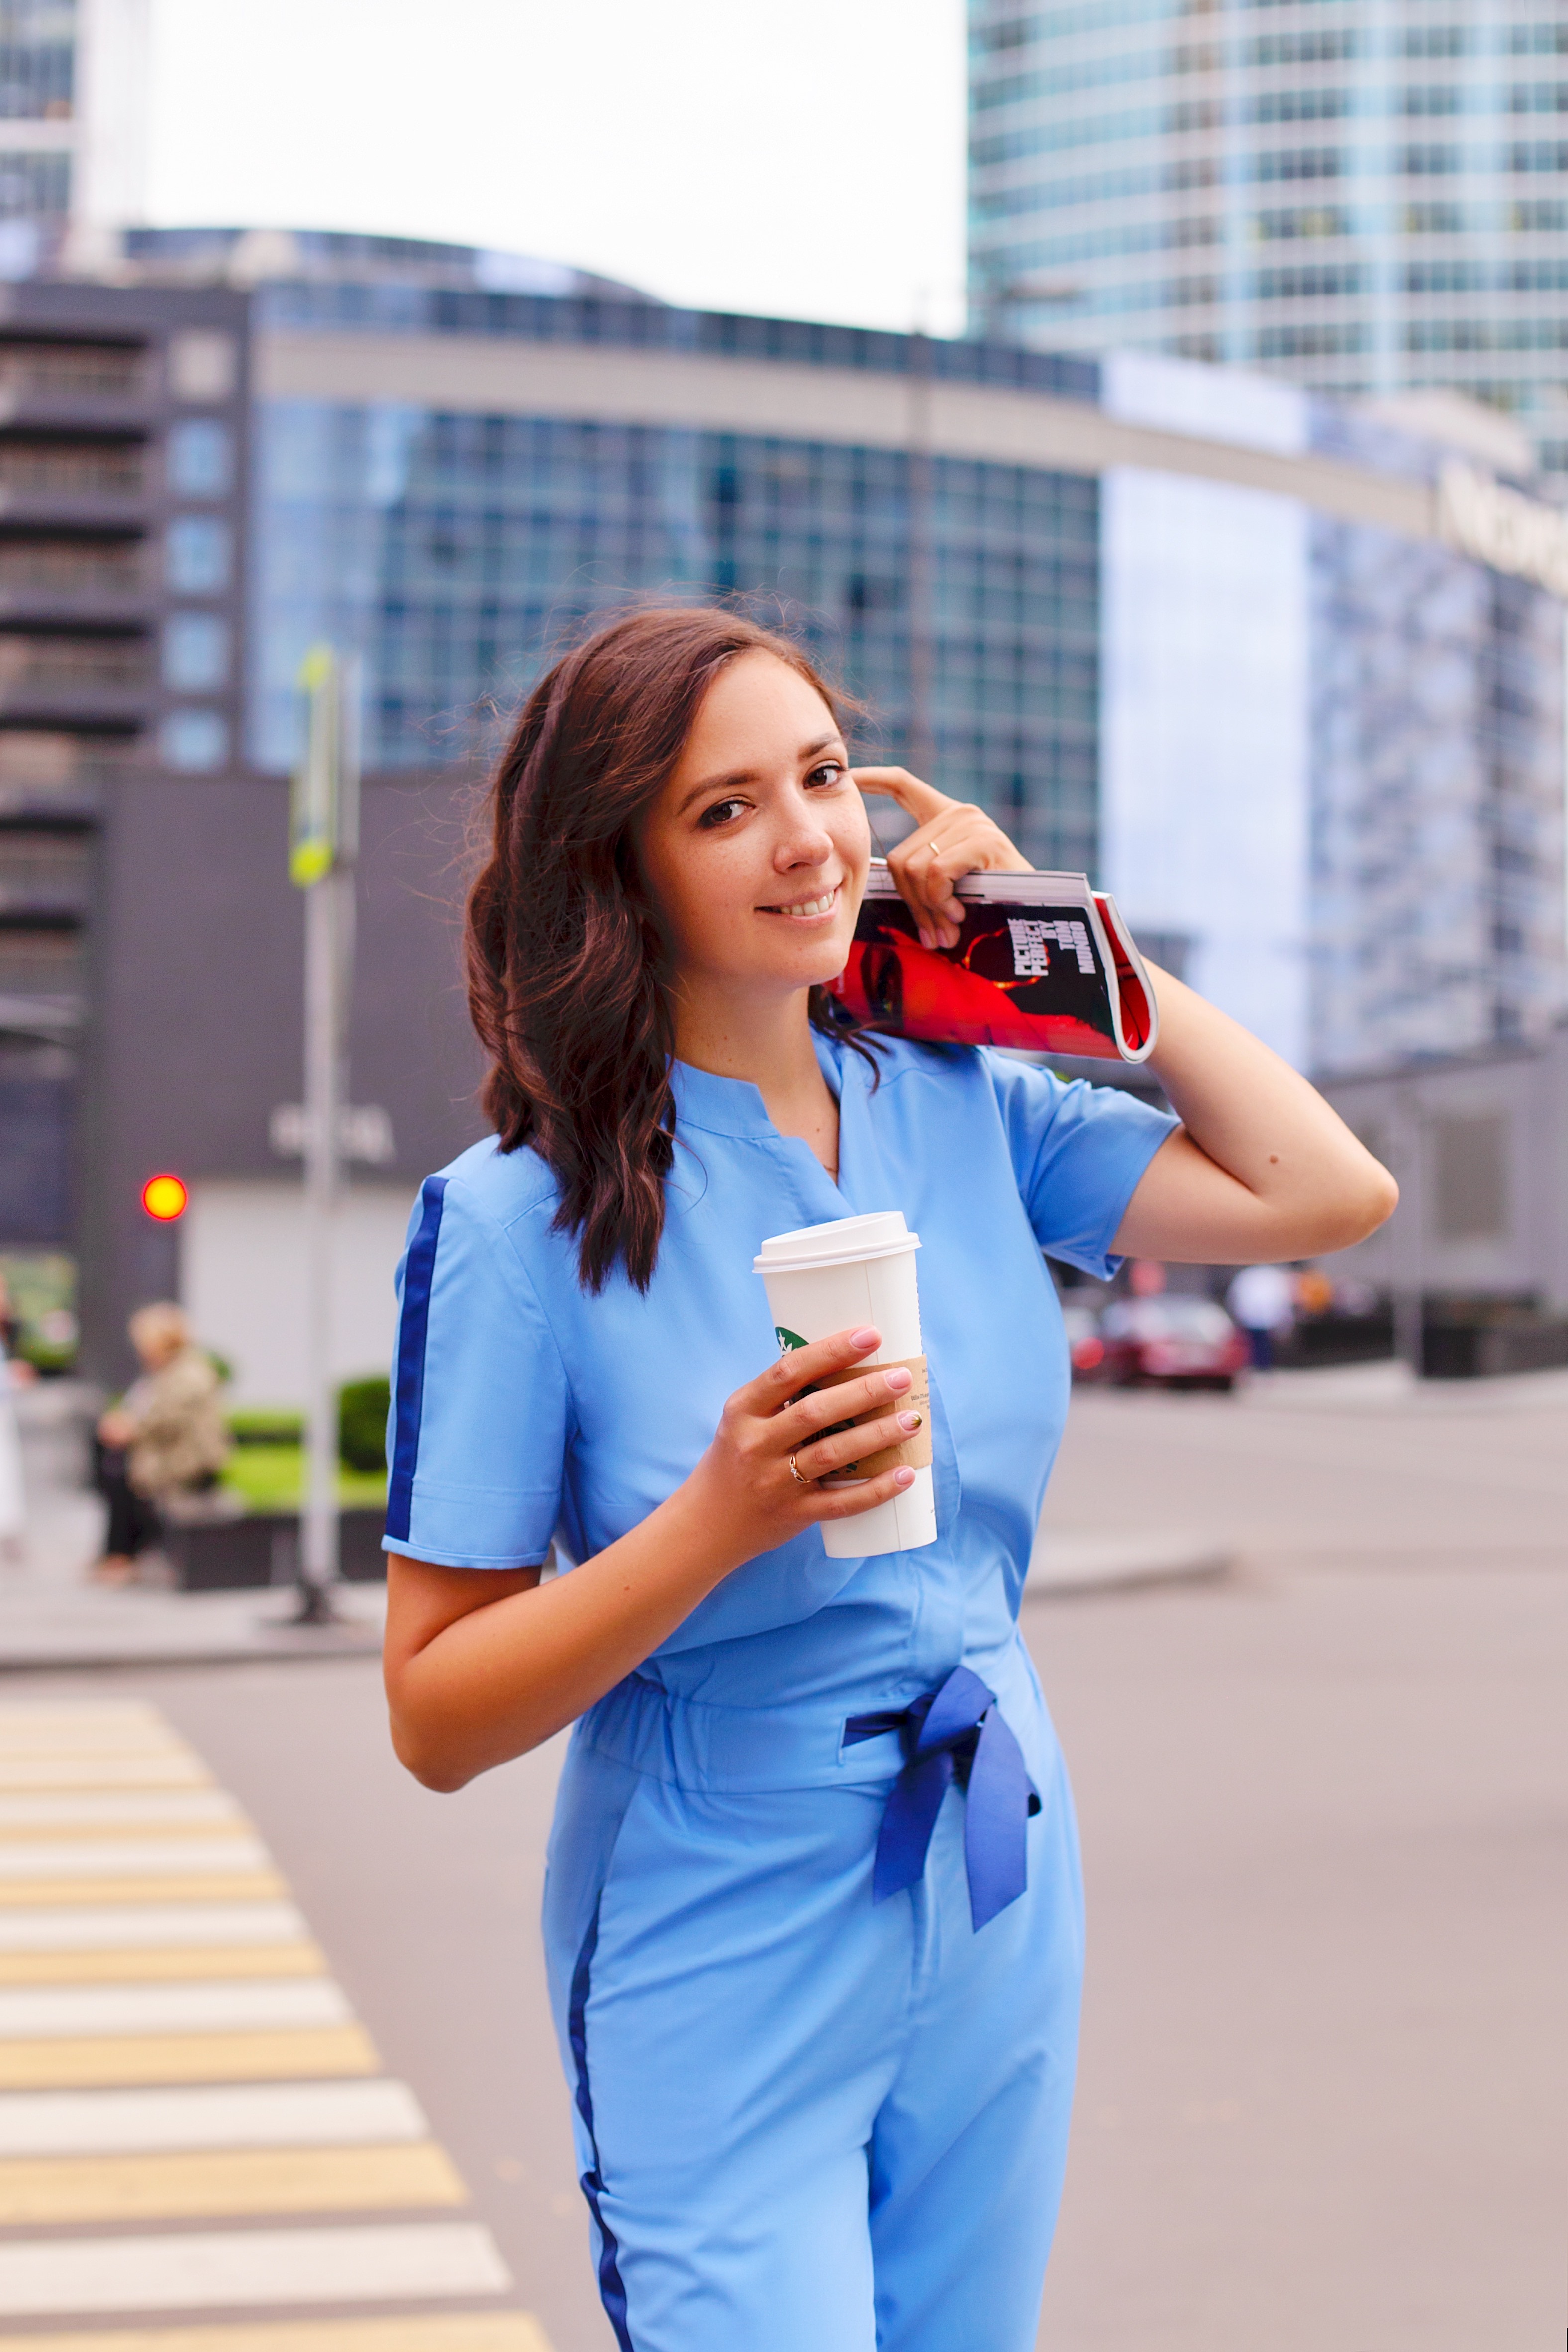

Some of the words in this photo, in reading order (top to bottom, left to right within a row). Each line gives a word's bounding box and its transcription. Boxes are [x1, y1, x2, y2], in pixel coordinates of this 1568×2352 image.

[1007, 918, 1031, 976] PICTURE
[1022, 919, 1049, 976] PERFECT
[1037, 920, 1057, 939] BY
[1053, 920, 1076, 951] TOM
[1069, 921, 1096, 974] MUNRO
